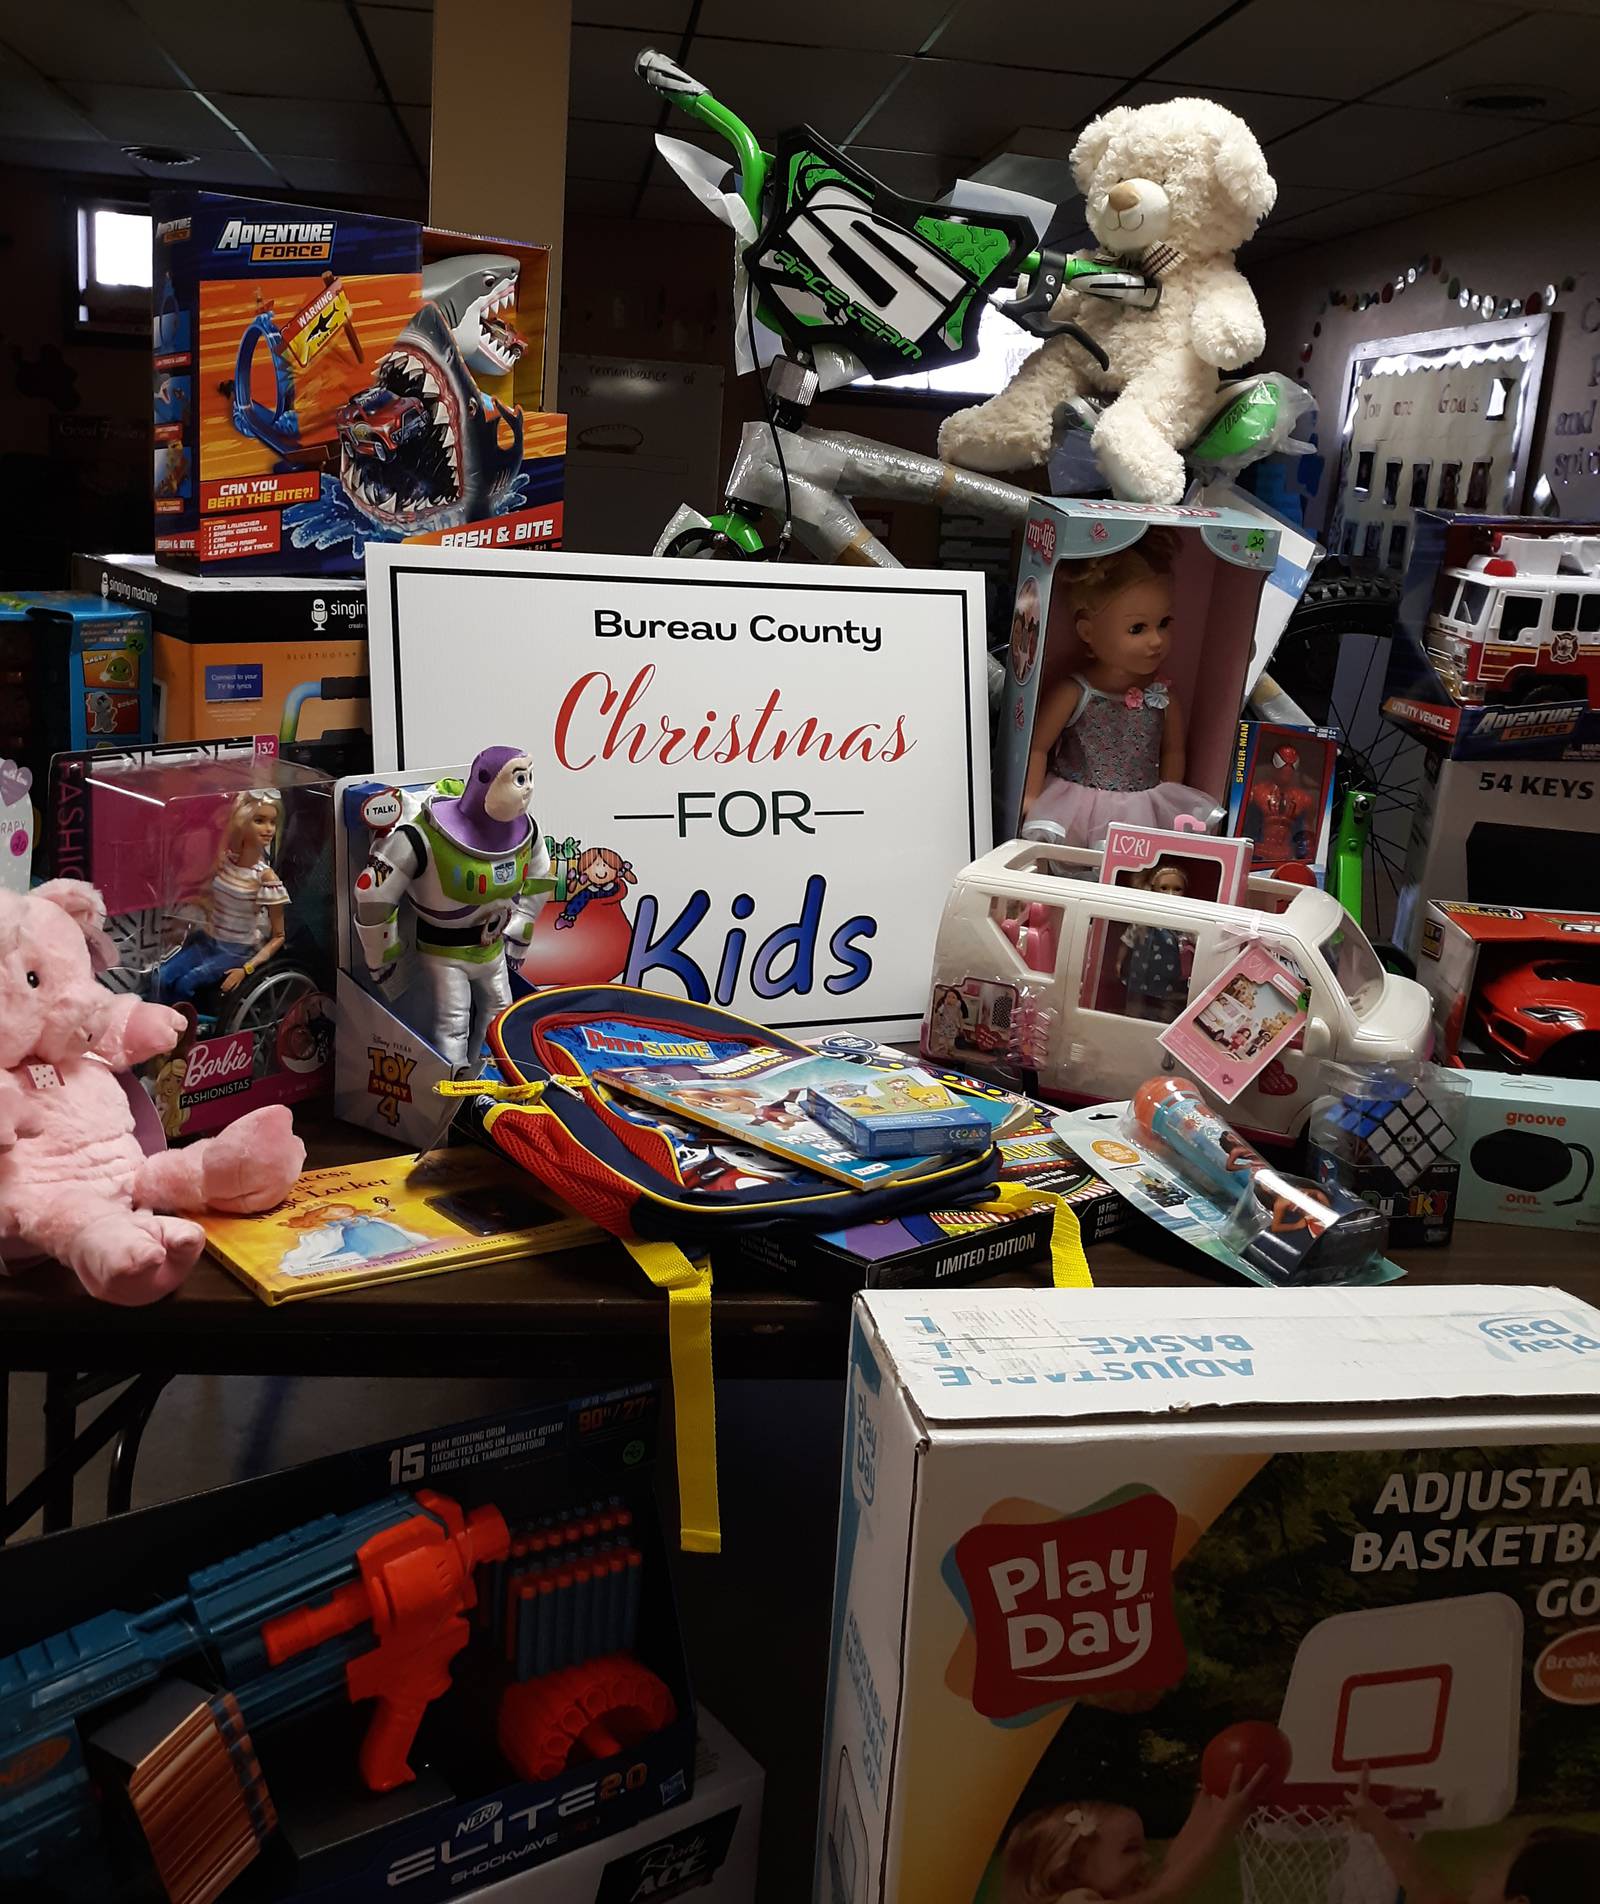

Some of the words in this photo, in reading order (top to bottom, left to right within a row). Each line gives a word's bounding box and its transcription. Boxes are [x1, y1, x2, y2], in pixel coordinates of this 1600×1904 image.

[217, 221, 334, 249] ADVENTURE
[260, 245, 323, 258] FORCE
[774, 249, 850, 308] RACE
[296, 290, 333, 328] WARNING
[845, 301, 924, 361] TEAM
[207, 495, 243, 510] BEAT
[246, 491, 272, 505] THE
[274, 487, 314, 502] BITE?!
[220, 483, 248, 496] CAN
[251, 479, 279, 493] YOU
[441, 528, 493, 548] BASH
[496, 525, 511, 543] &
[515, 518, 554, 540] BITE
[109, 577, 131, 600] singing
[132, 586, 158, 606] machine
[330, 599, 367, 619] singin
[593, 609, 737, 642] Bureau
[749, 614, 883, 652] County
[553, 663, 918, 771] Christmas
[1391, 702, 1418, 719] UTILITY
[1419, 711, 1451, 730] VEHICLE
[1472, 706, 1584, 736] ADVENTURE
[1508, 723, 1569, 739] FORCE
[256, 742, 275, 754] 132
[1235, 722, 1250, 784] SPIDER-MAN
[1479, 771, 1513, 793] 54
[1520, 776, 1595, 800] KEYS
[372, 804, 397, 815] TALK!
[677, 789, 817, 839] FOR
[622, 874, 877, 1006] Kids
[584, 1028, 714, 1060] PAWSOME
[184, 1040, 252, 1088] Barbie
[368, 1047, 417, 1086] TOY
[181, 1078, 251, 1107] FASHIONISTAS
[370, 1077, 411, 1102] STORY
[378, 1095, 399, 1127] 4
[1506, 1111, 1566, 1127] groove
[817, 1151, 861, 1165] ACT
[306, 1179, 391, 1198] Locket
[1506, 1193, 1541, 1206] onn.
[935, 1247, 986, 1278] LIMITED
[987, 1232, 1036, 1262] EDITION
[1479, 1317, 1572, 1339] Day
[1509, 1333, 1600, 1354] Play
[933, 1358, 1254, 1387] ADJUSTE
[432, 1438, 450, 1450] DART
[451, 1431, 485, 1448] ROTATING
[486, 1424, 506, 1439] DRUM
[858, 1393, 877, 1458] Play
[388, 1442, 425, 1485] 15
[857, 1432, 876, 1506] Day
[1372, 1466, 1600, 1521] ADJUSTA
[988, 1539, 1148, 1614] Play
[1007, 1602, 1153, 1682] Day
[599, 1762, 649, 1802] 2.0
[386, 1780, 600, 1888] ELITE
[455, 1801, 504, 1839] NERF
[449, 1831, 560, 1886] SHOCKWAVE
